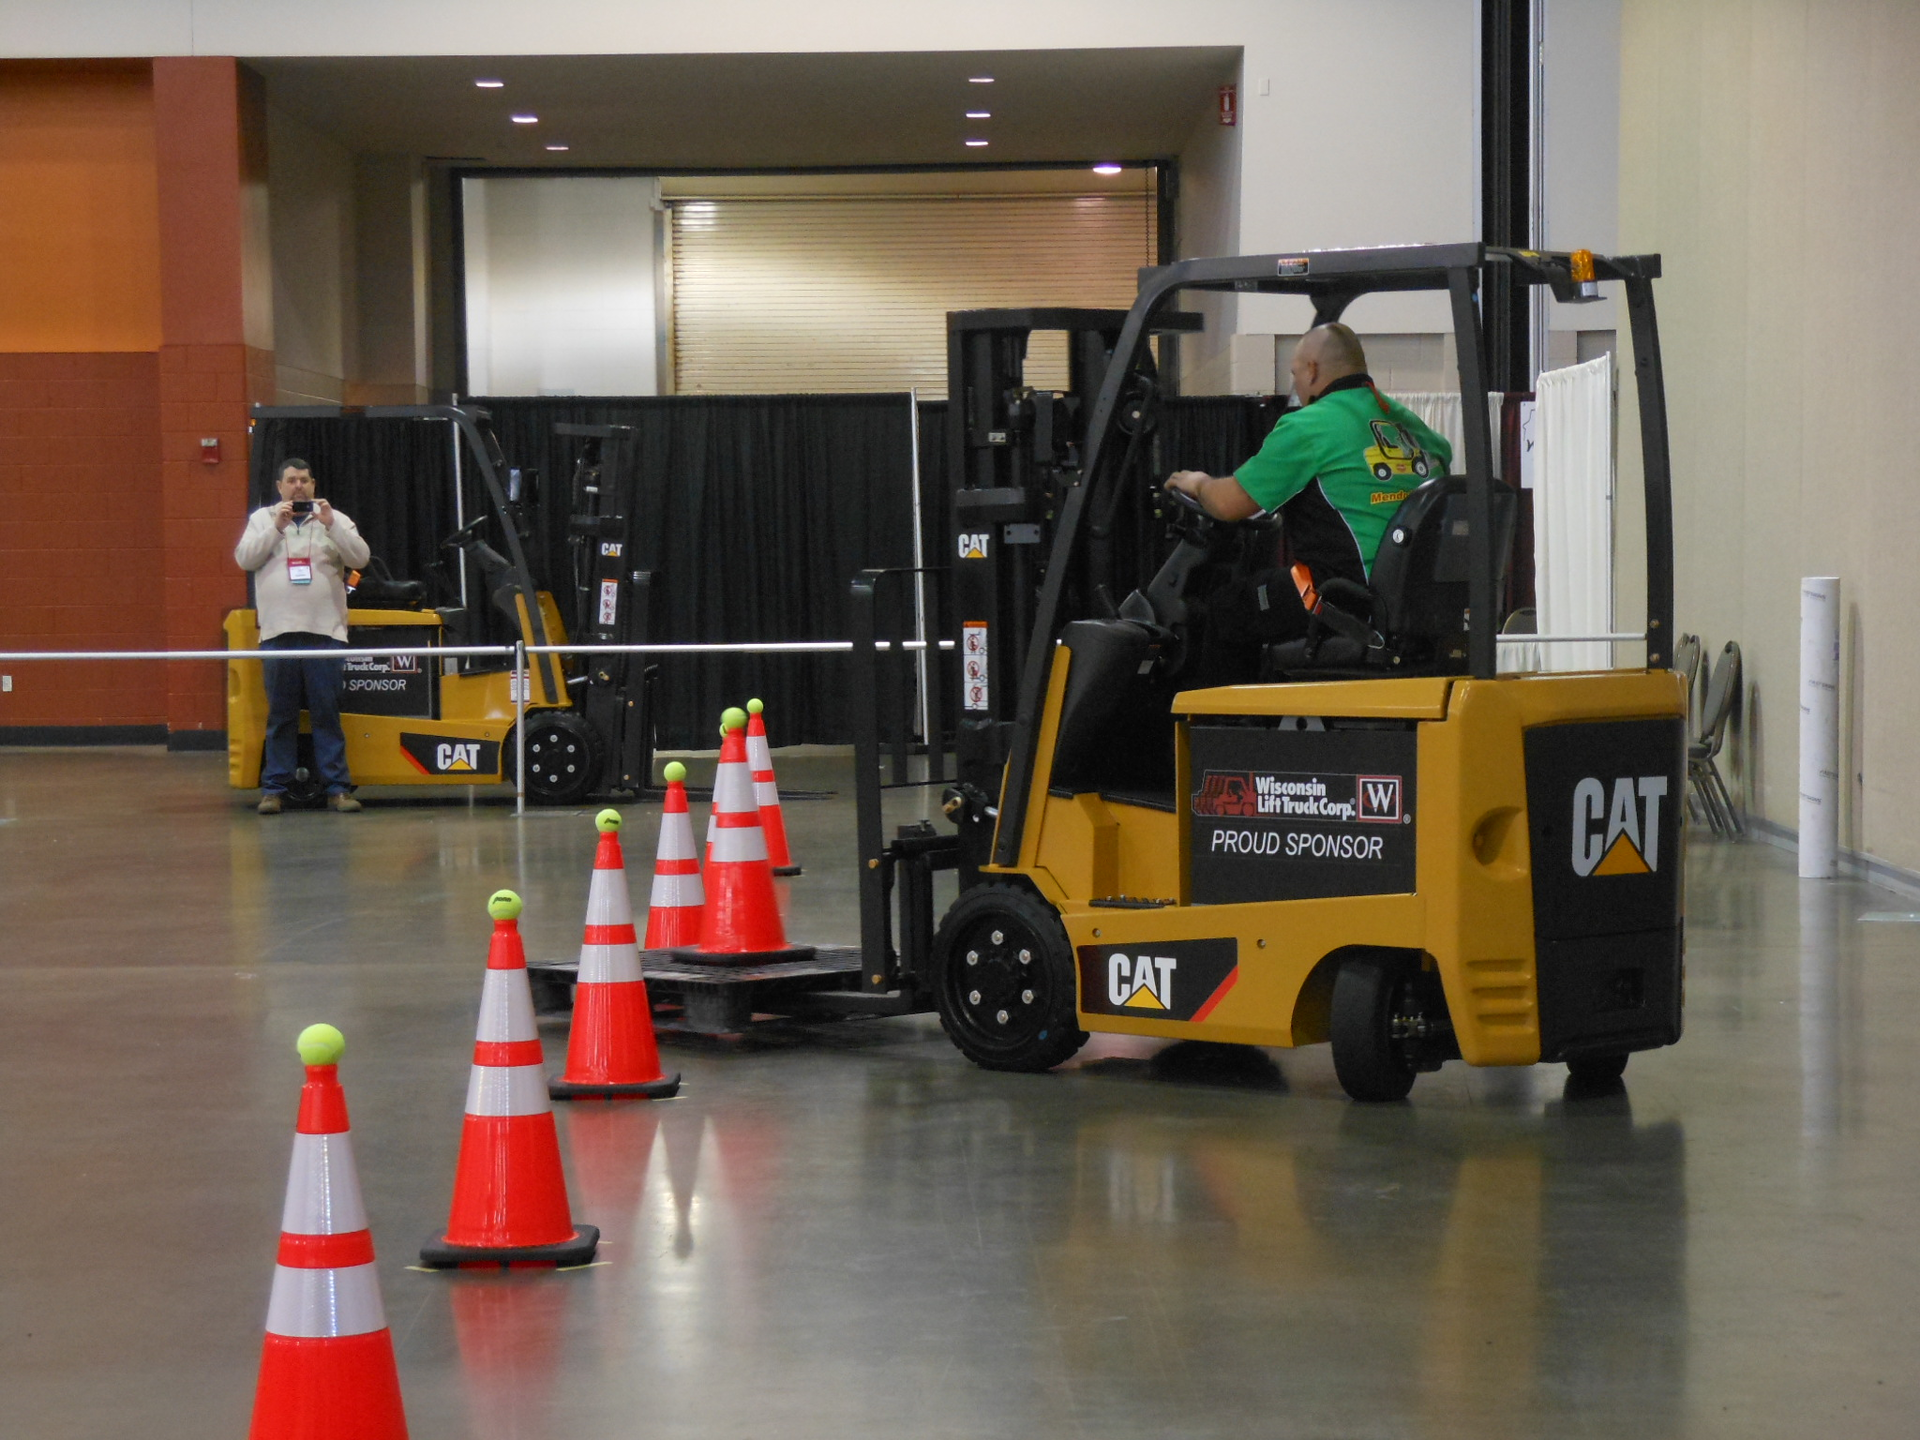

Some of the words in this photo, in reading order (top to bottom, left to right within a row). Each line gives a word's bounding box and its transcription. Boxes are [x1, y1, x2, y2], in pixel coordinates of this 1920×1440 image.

[601, 542, 623, 557] CAT
[958, 533, 990, 558] CAT
[348, 679, 407, 691] SPONSOR
[437, 743, 481, 770] CAT
[1255, 776, 1326, 797] Wisconsin
[1366, 783, 1394, 814] W
[1257, 795, 1281, 813] Lift
[1281, 796, 1319, 815] Truck
[1319, 797, 1356, 821] Corp.
[1571, 775, 1667, 877] CAT
[1211, 829, 1281, 854] PROUD
[1285, 832, 1383, 859] SPONSOR
[1108, 953, 1177, 1010] CAT
